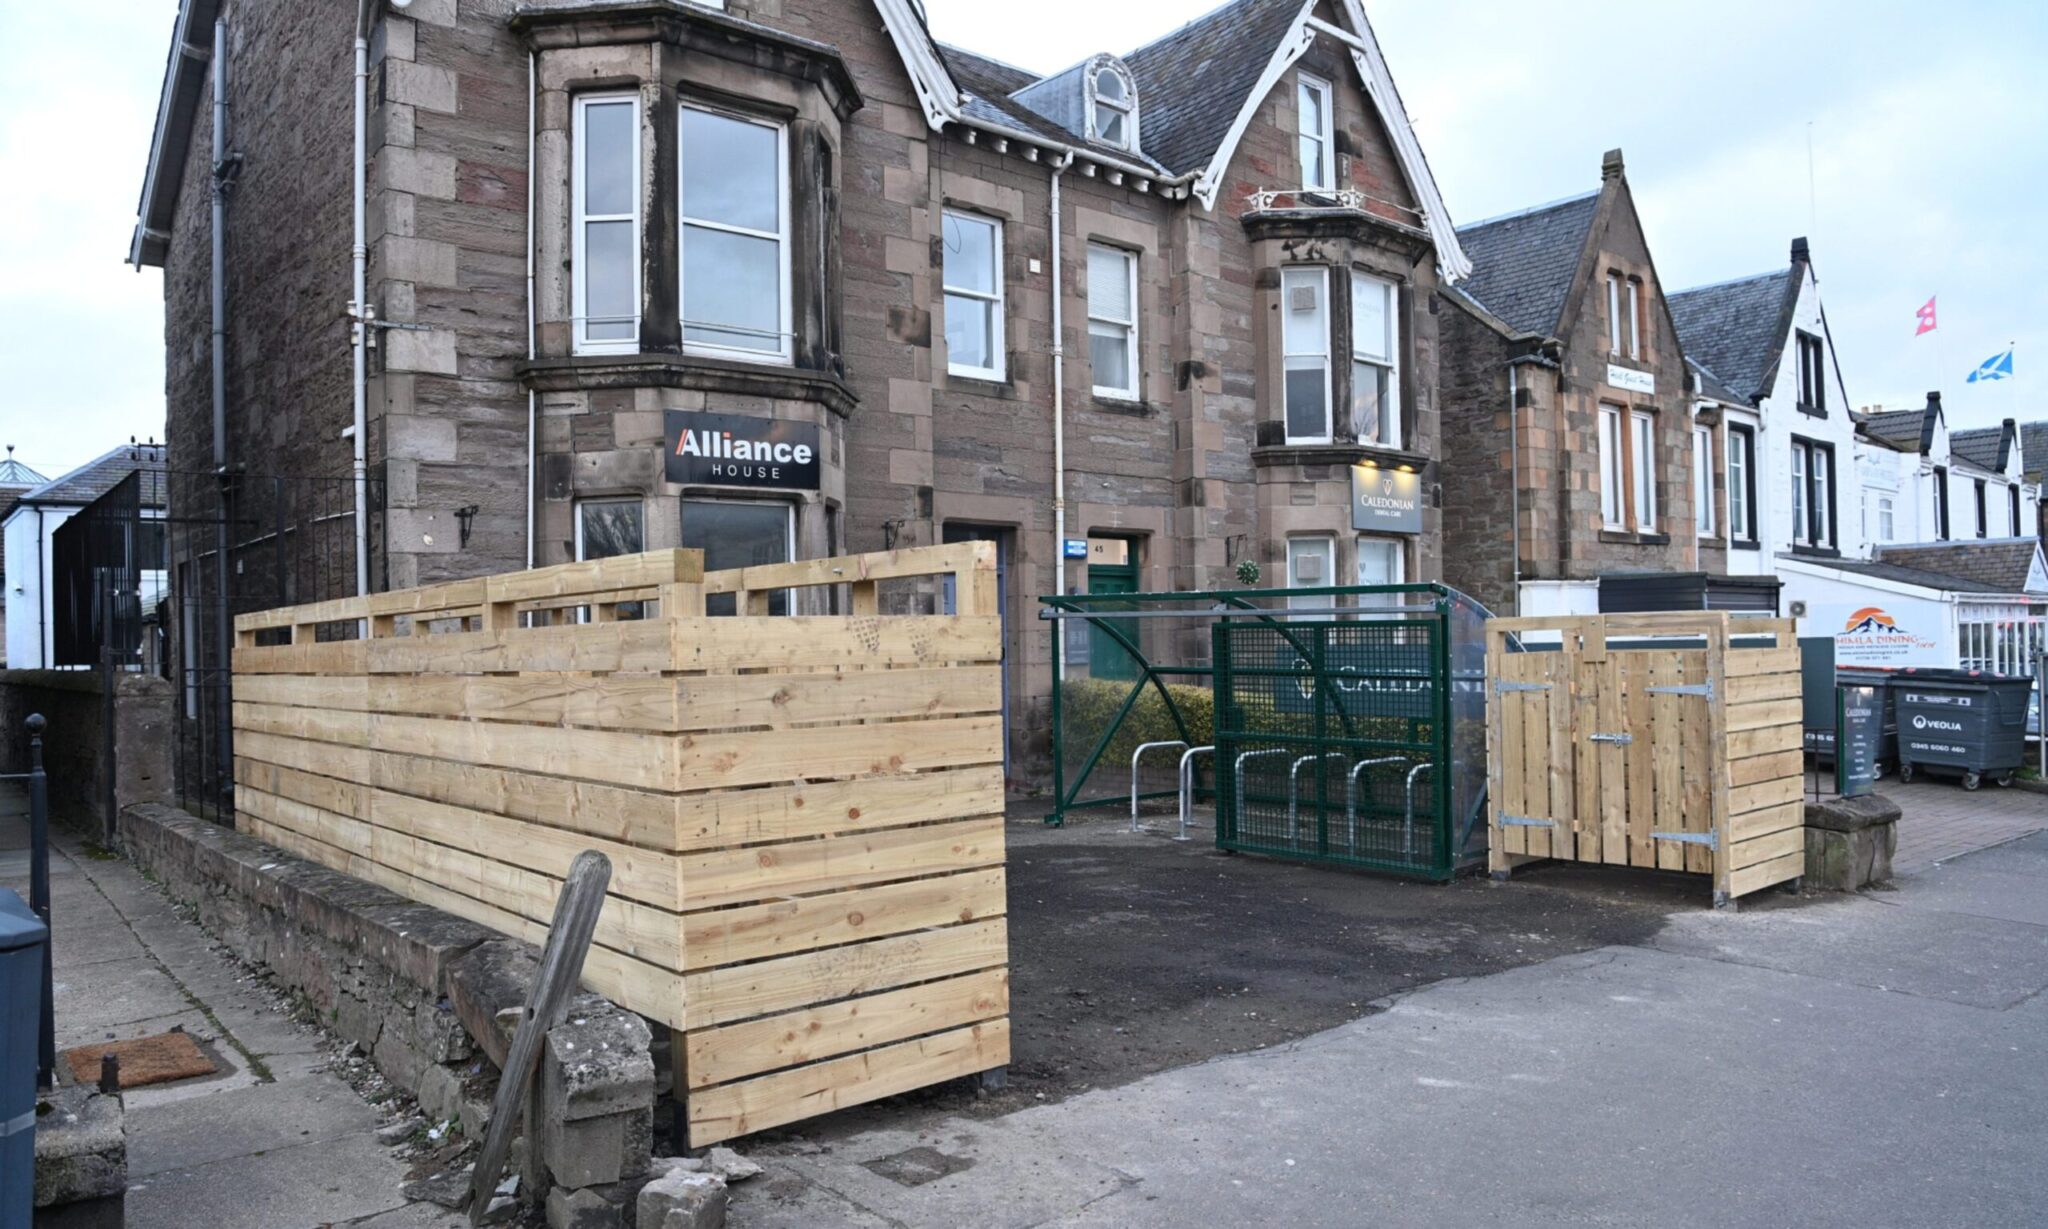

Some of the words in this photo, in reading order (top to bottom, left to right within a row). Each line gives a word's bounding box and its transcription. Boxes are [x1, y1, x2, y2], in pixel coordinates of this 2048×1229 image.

[675, 428, 812, 465] Alliance
[712, 464, 781, 480] HOUSE
[1361, 494, 1414, 510] CALEDONIAN
[1094, 545, 1104, 553] 45
[1876, 634, 1918, 644] DINING
[1927, 720, 1962, 731] VEOLIA
